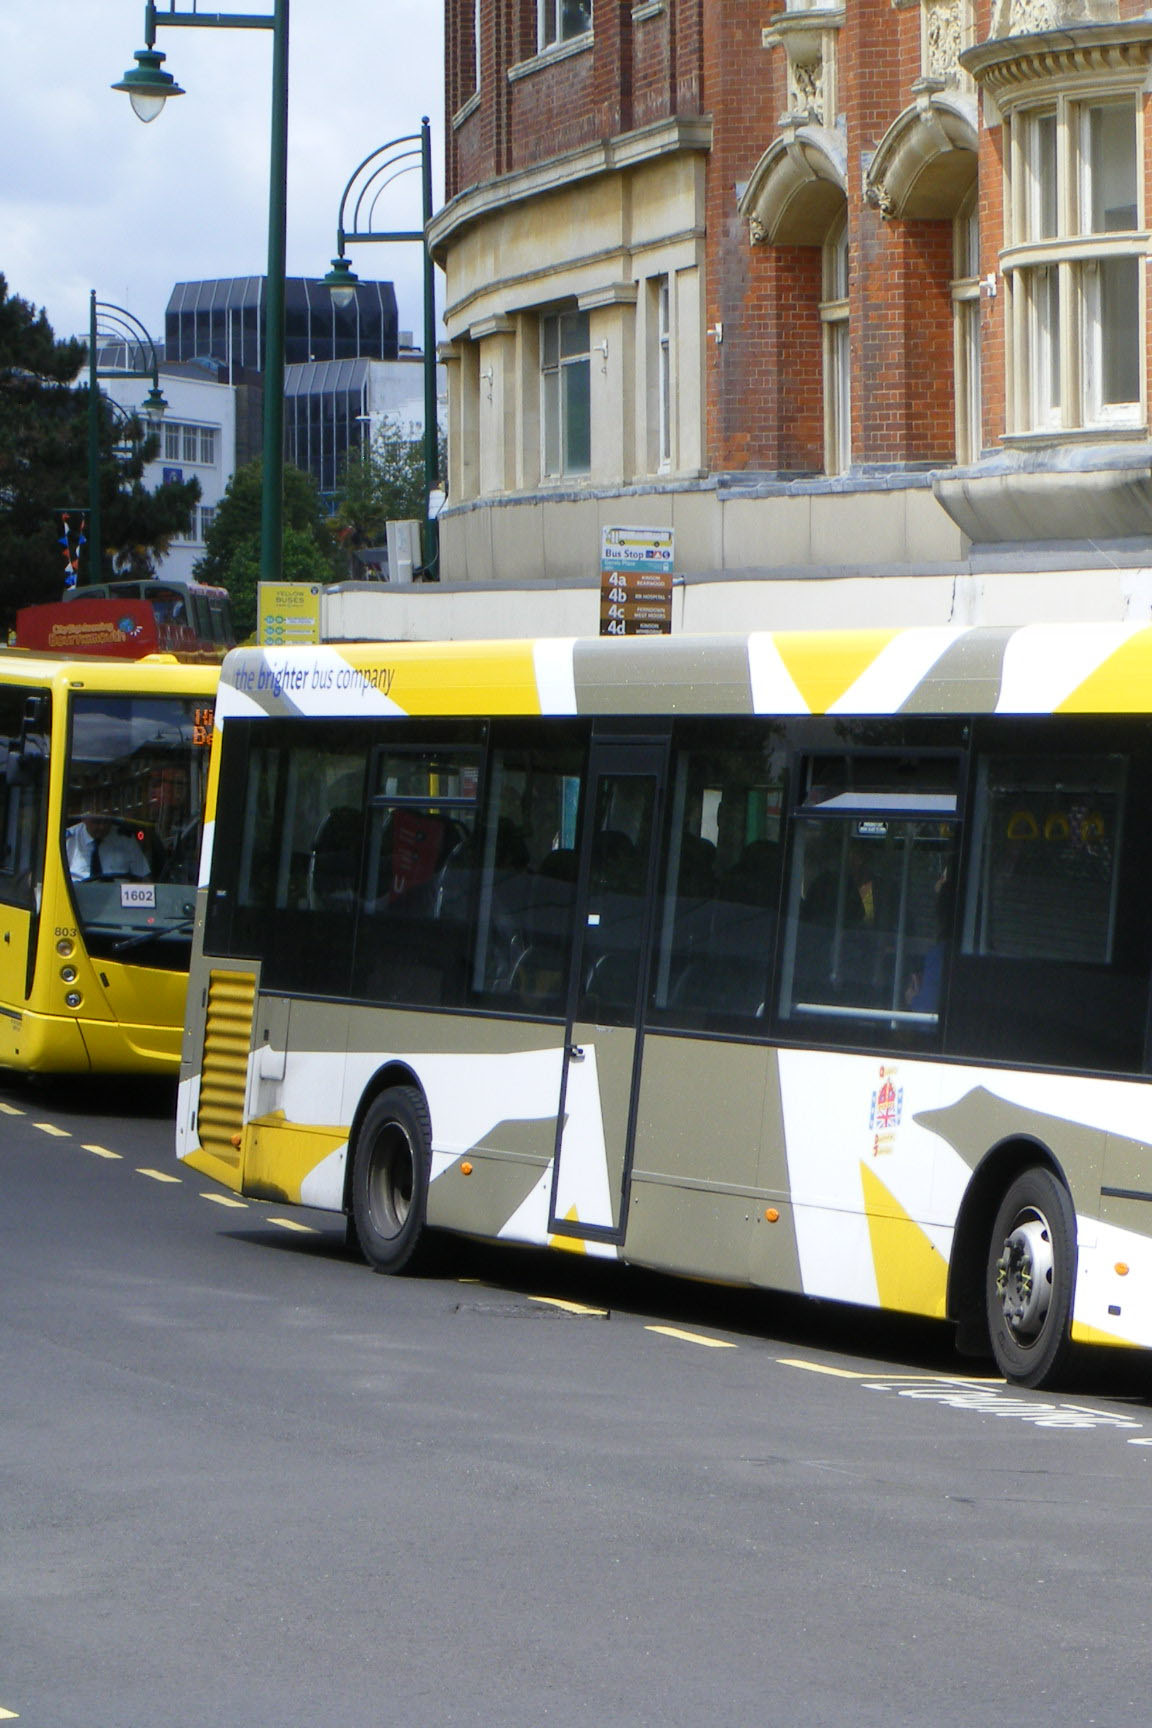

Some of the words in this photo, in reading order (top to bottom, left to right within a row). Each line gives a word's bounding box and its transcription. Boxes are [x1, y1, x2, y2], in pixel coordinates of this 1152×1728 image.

[605, 549, 621, 558] Bus
[624, 549, 644, 560] Stop
[608, 572, 627, 587] 4a
[608, 588, 627, 602] 4b
[608, 604, 625, 619] 4c
[607, 620, 626, 635] 4d
[235, 661, 255, 690] the
[257, 661, 308, 697] brighter
[311, 660, 333, 690] bus
[336, 667, 395, 697] company
[123, 890, 153, 902] 1602
[54, 927, 77, 937] 803
